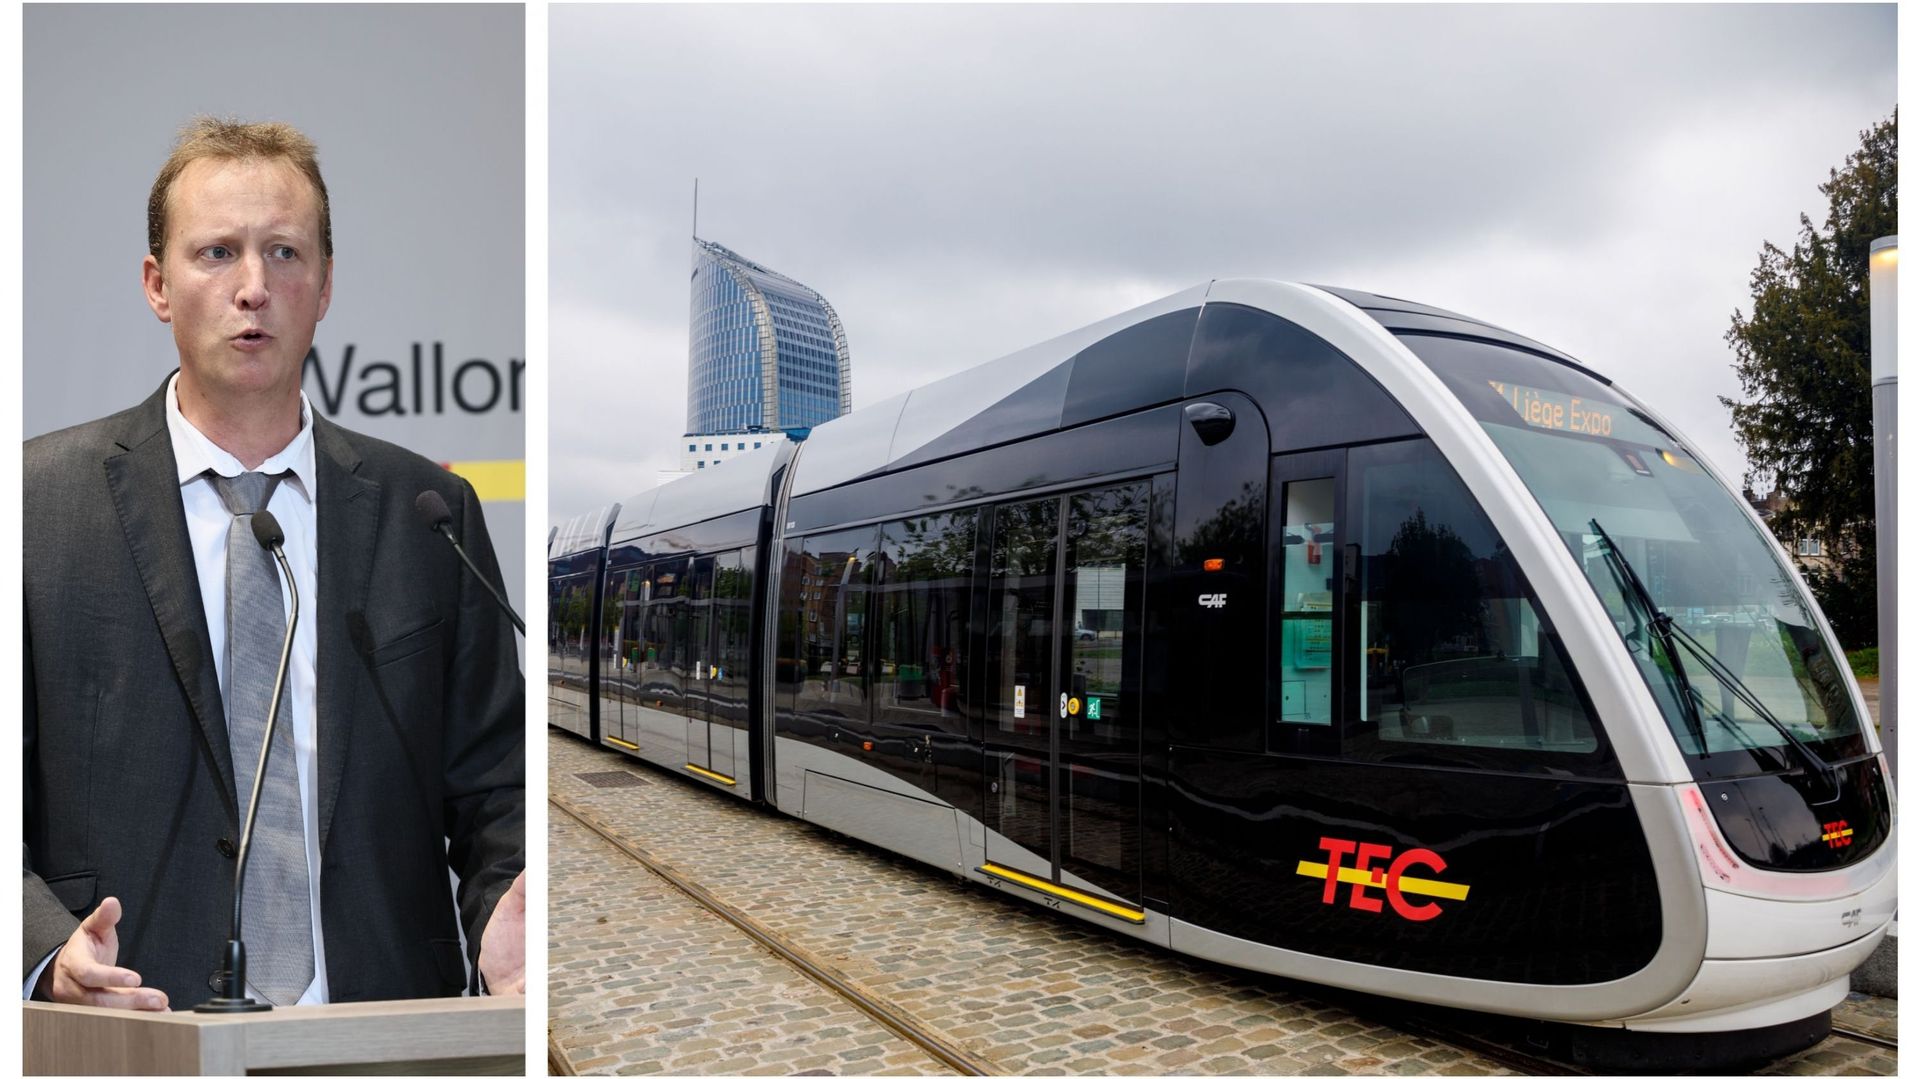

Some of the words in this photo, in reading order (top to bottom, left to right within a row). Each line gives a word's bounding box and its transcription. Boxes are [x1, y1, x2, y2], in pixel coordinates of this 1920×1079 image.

[1570, 399, 1612, 437] Expo
[1198, 593, 1227, 608] CAF
[1823, 820, 1852, 849] TEC
[1319, 836, 1448, 921] TEC
